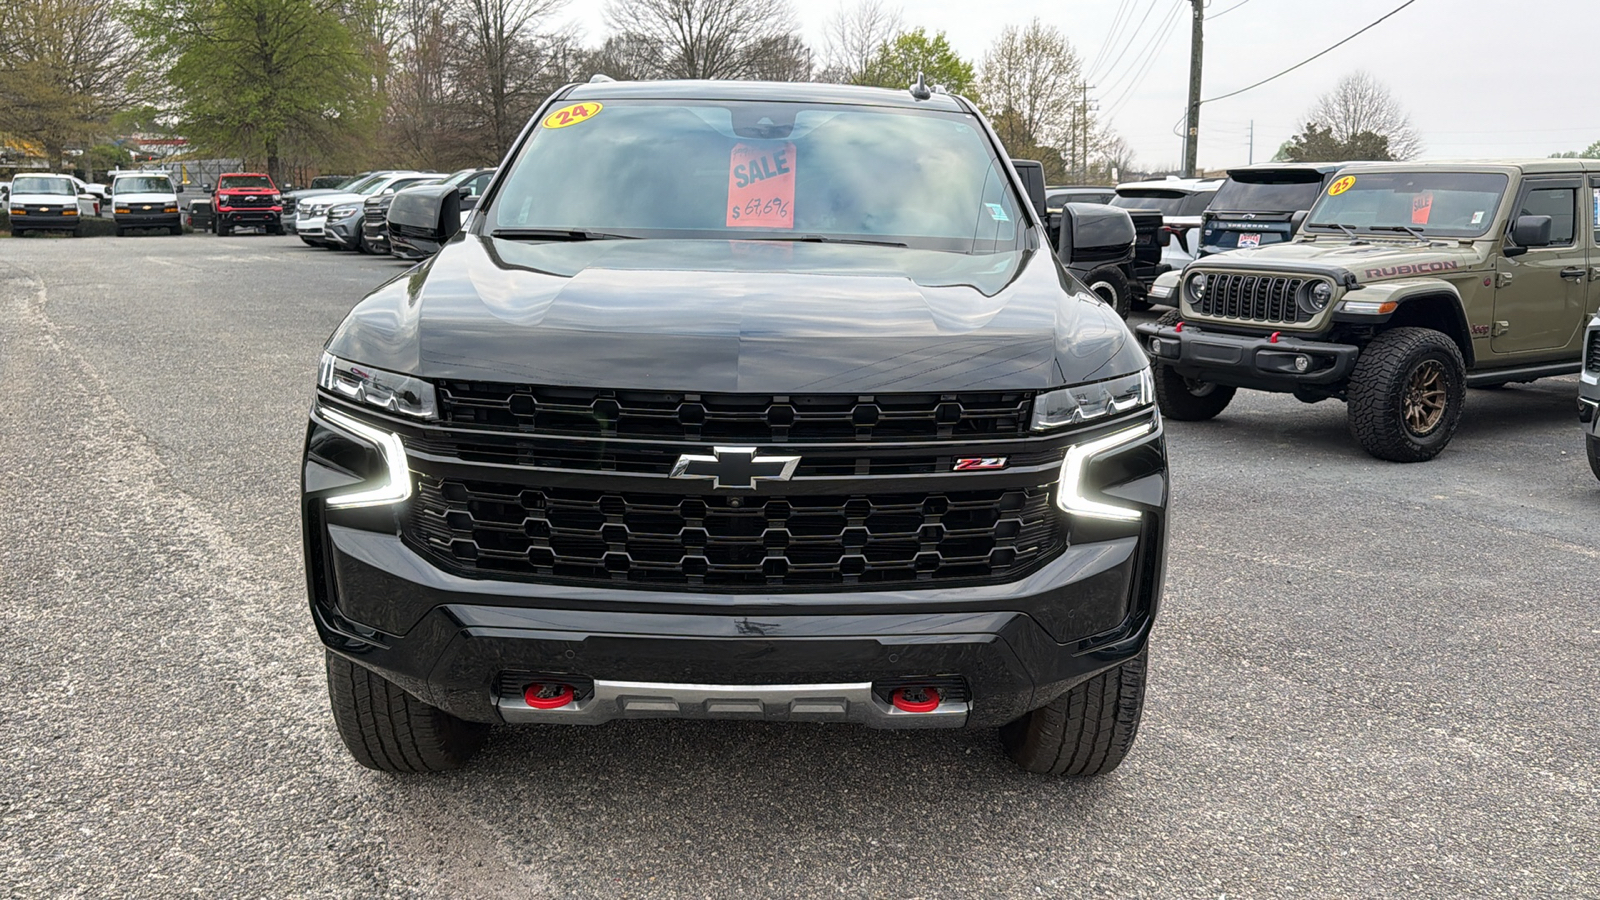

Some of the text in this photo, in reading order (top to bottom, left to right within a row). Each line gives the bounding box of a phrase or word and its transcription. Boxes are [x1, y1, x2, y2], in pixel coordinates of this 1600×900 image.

[556, 105, 589, 125] 24
[733, 149, 790, 188] SALE
[1333, 177, 1350, 194] 25
[744, 197, 790, 218] 67,696
[1364, 260, 1458, 279] RUBICON
[953, 457, 1007, 471] Z71
